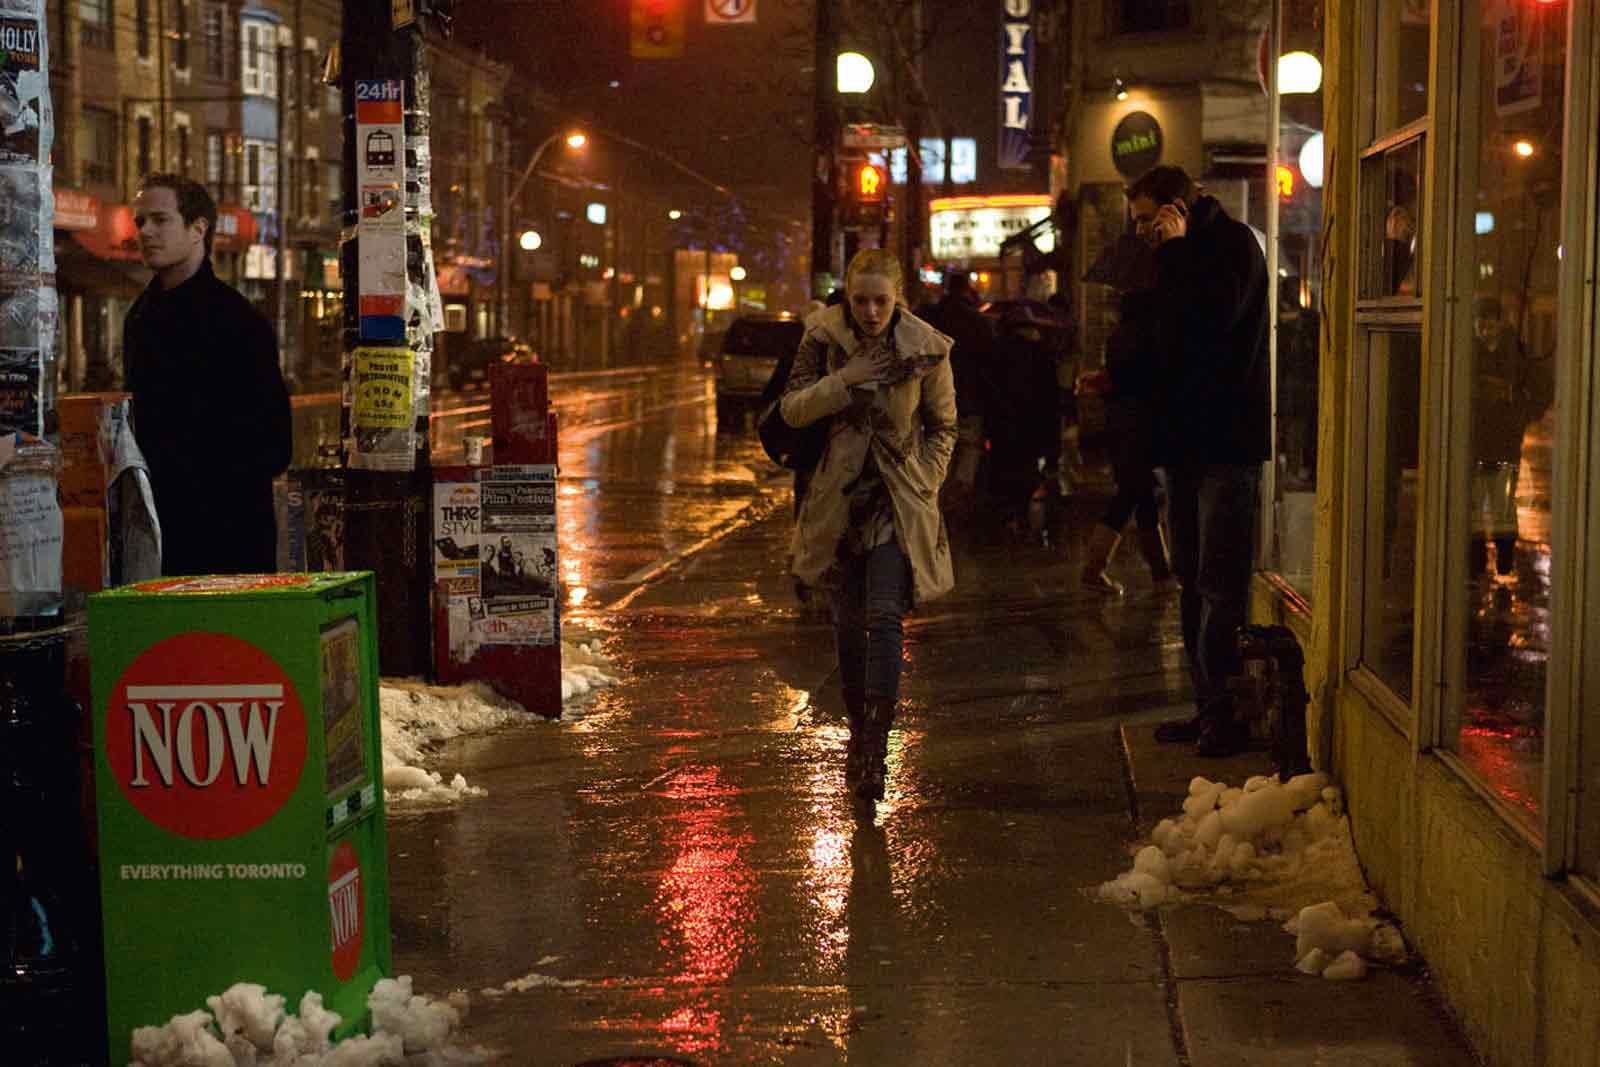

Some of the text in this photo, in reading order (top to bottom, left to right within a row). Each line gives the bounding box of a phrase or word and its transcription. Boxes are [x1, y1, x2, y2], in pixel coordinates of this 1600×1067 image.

[357, 82, 400, 99] 24Hr
[125, 701, 286, 789] NOW
[120, 862, 307, 881] EVERYTHING TORONTO
[329, 877, 360, 953] NOW
